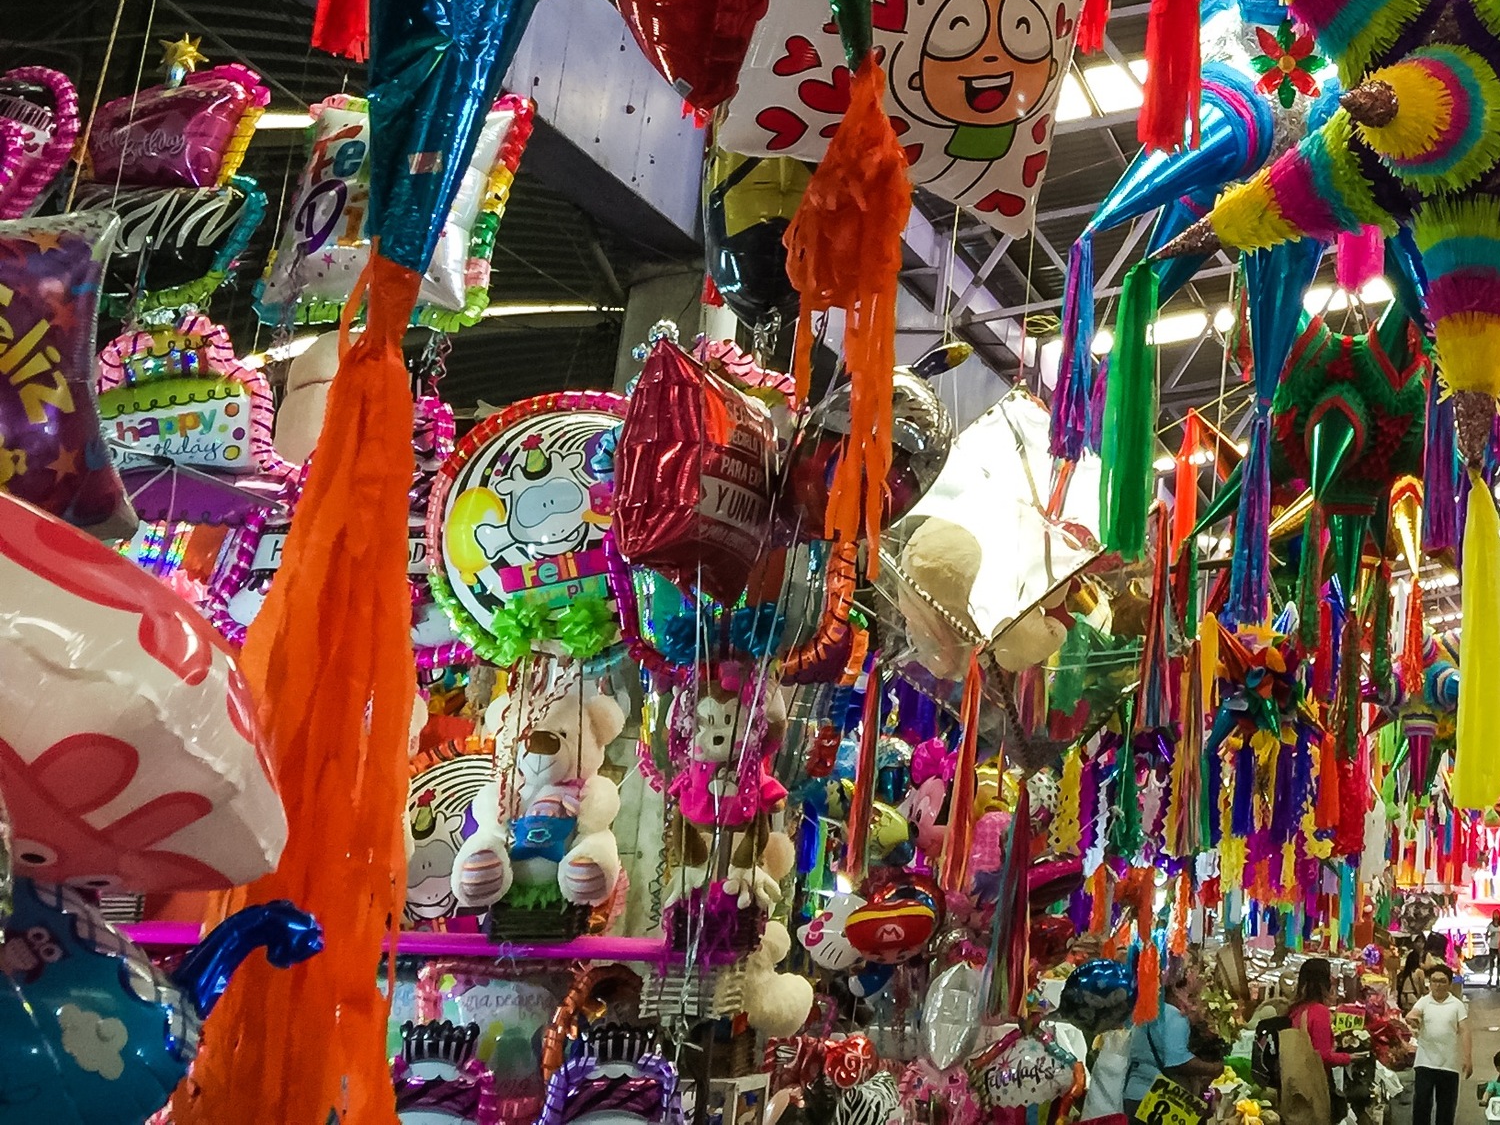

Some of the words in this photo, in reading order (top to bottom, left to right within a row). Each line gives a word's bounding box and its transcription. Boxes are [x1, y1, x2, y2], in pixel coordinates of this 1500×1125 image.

[115, 408, 218, 442] happy
[720, 456, 747, 482] PARA
[715, 484, 729, 513] Y
